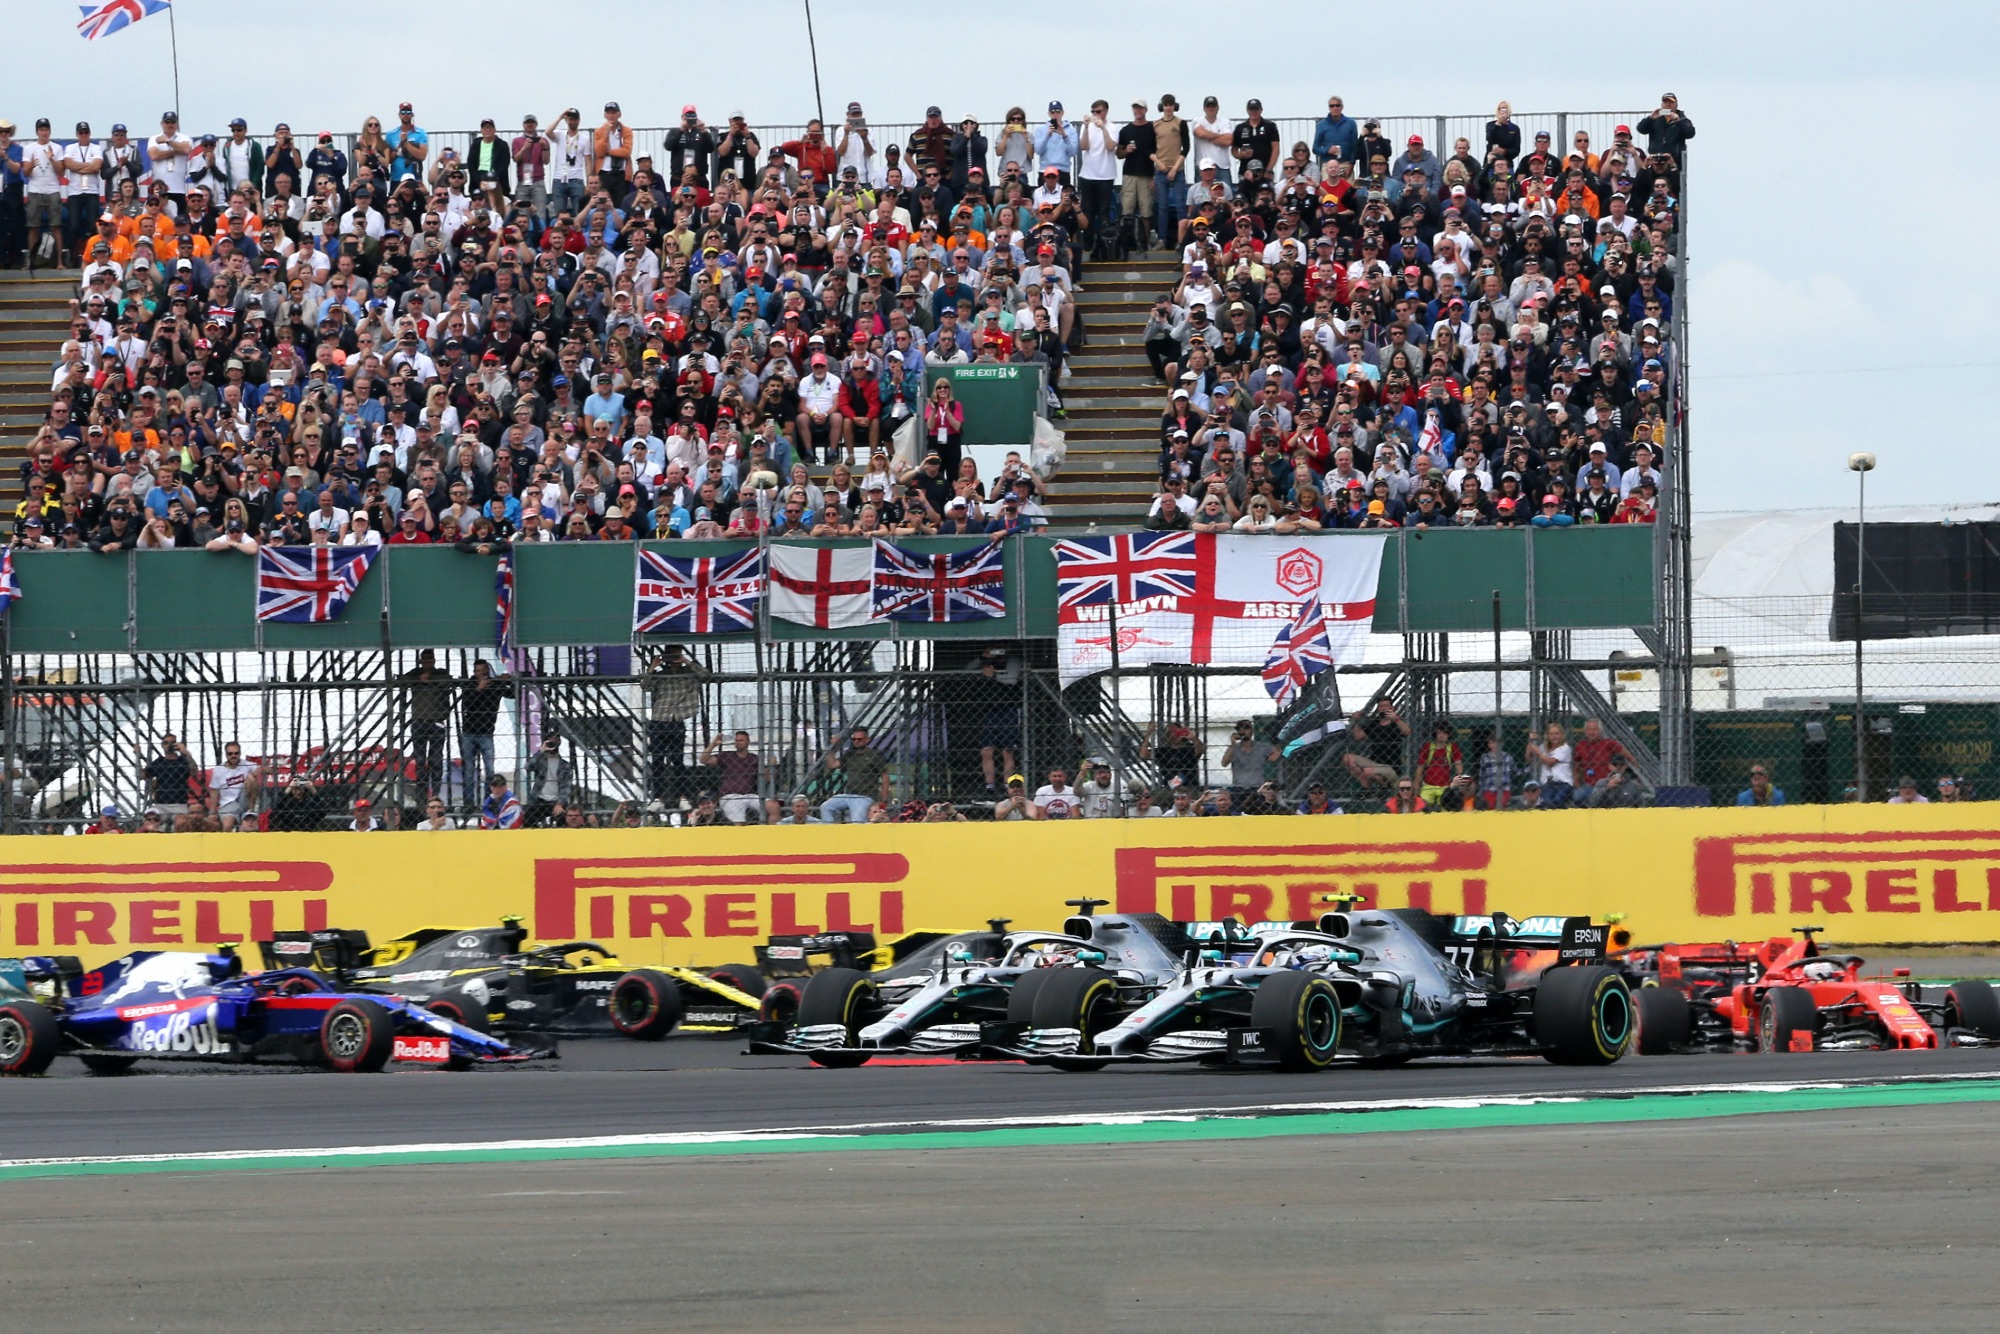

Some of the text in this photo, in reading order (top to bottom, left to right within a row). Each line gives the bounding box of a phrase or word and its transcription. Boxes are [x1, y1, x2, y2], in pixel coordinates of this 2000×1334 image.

[955, 368, 997, 377] FIRE EXIT
[648, 580, 758, 599] LEWIS 44
[875, 574, 960, 594] STRONGER
[1242, 603, 1347, 619] ARSEAL
[535, 853, 910, 940] PIRELLI
[1575, 928, 1602, 943] EPSON
[372, 941, 418, 966] 27
[1445, 946, 1474, 982] 77
[575, 980, 616, 991] MAPF
[685, 1012, 737, 1022] RENAULT
[1242, 1032, 1260, 1046] IWC
